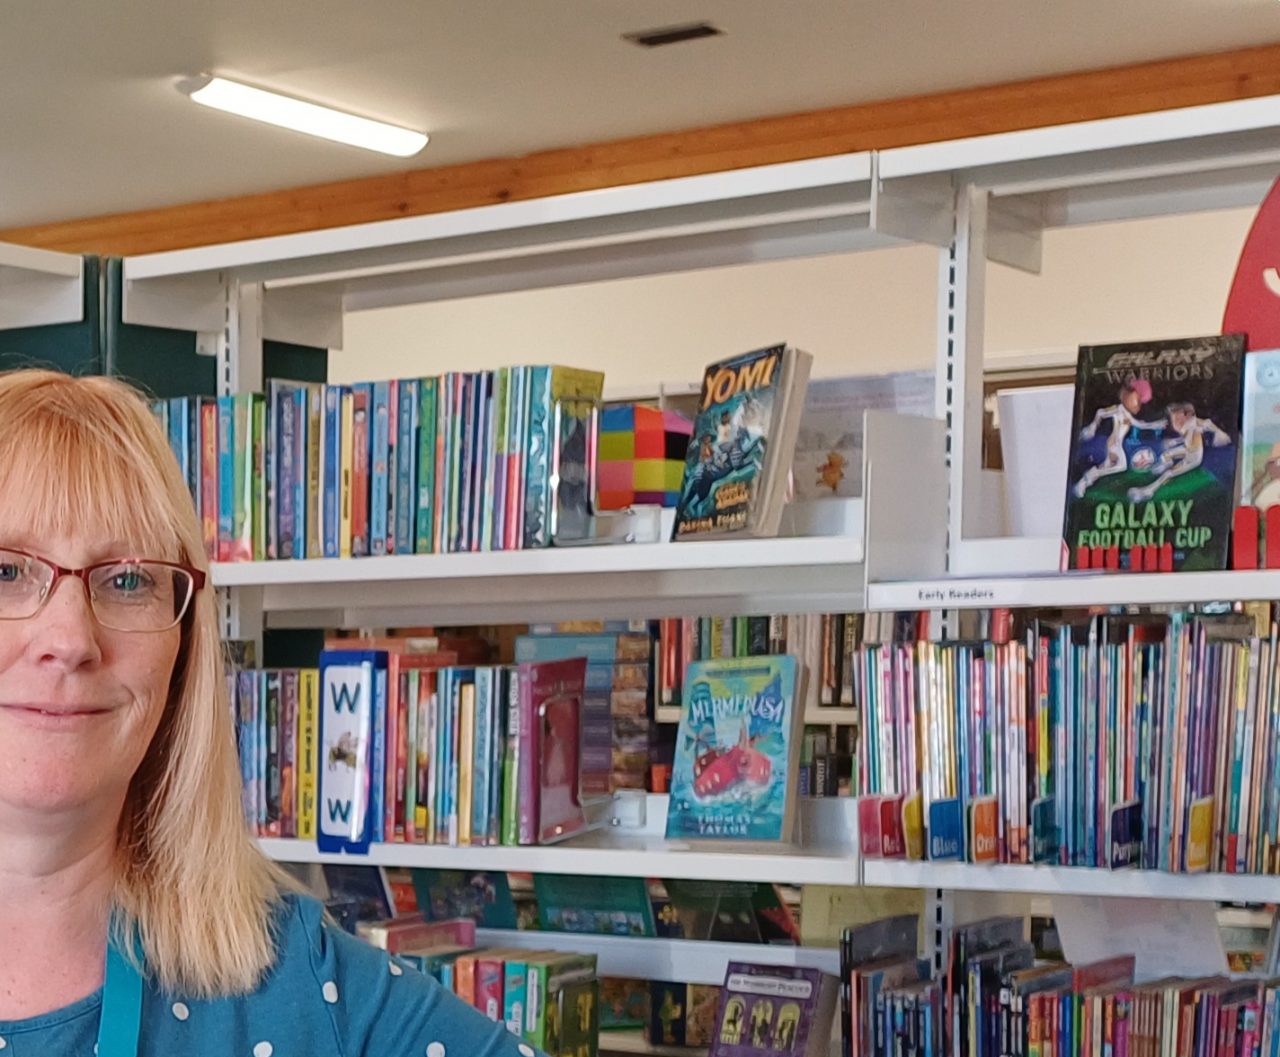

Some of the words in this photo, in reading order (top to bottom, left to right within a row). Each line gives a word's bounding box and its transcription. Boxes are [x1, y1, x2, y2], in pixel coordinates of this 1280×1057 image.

[703, 354, 778, 411] YOMI
[1094, 364, 1215, 385] WARRIORS
[1094, 499, 1194, 528] GALAXY
[1176, 525, 1213, 548] CUP
[917, 588, 946, 602] Early
[949, 588, 995, 600] Readers
[331, 682, 361, 713] W
[689, 695, 785, 727] MERMEDUSA
[697, 815, 752, 825] THOMAS
[699, 824, 748, 836] TAYLOR
[932, 835, 959, 857] Blue
